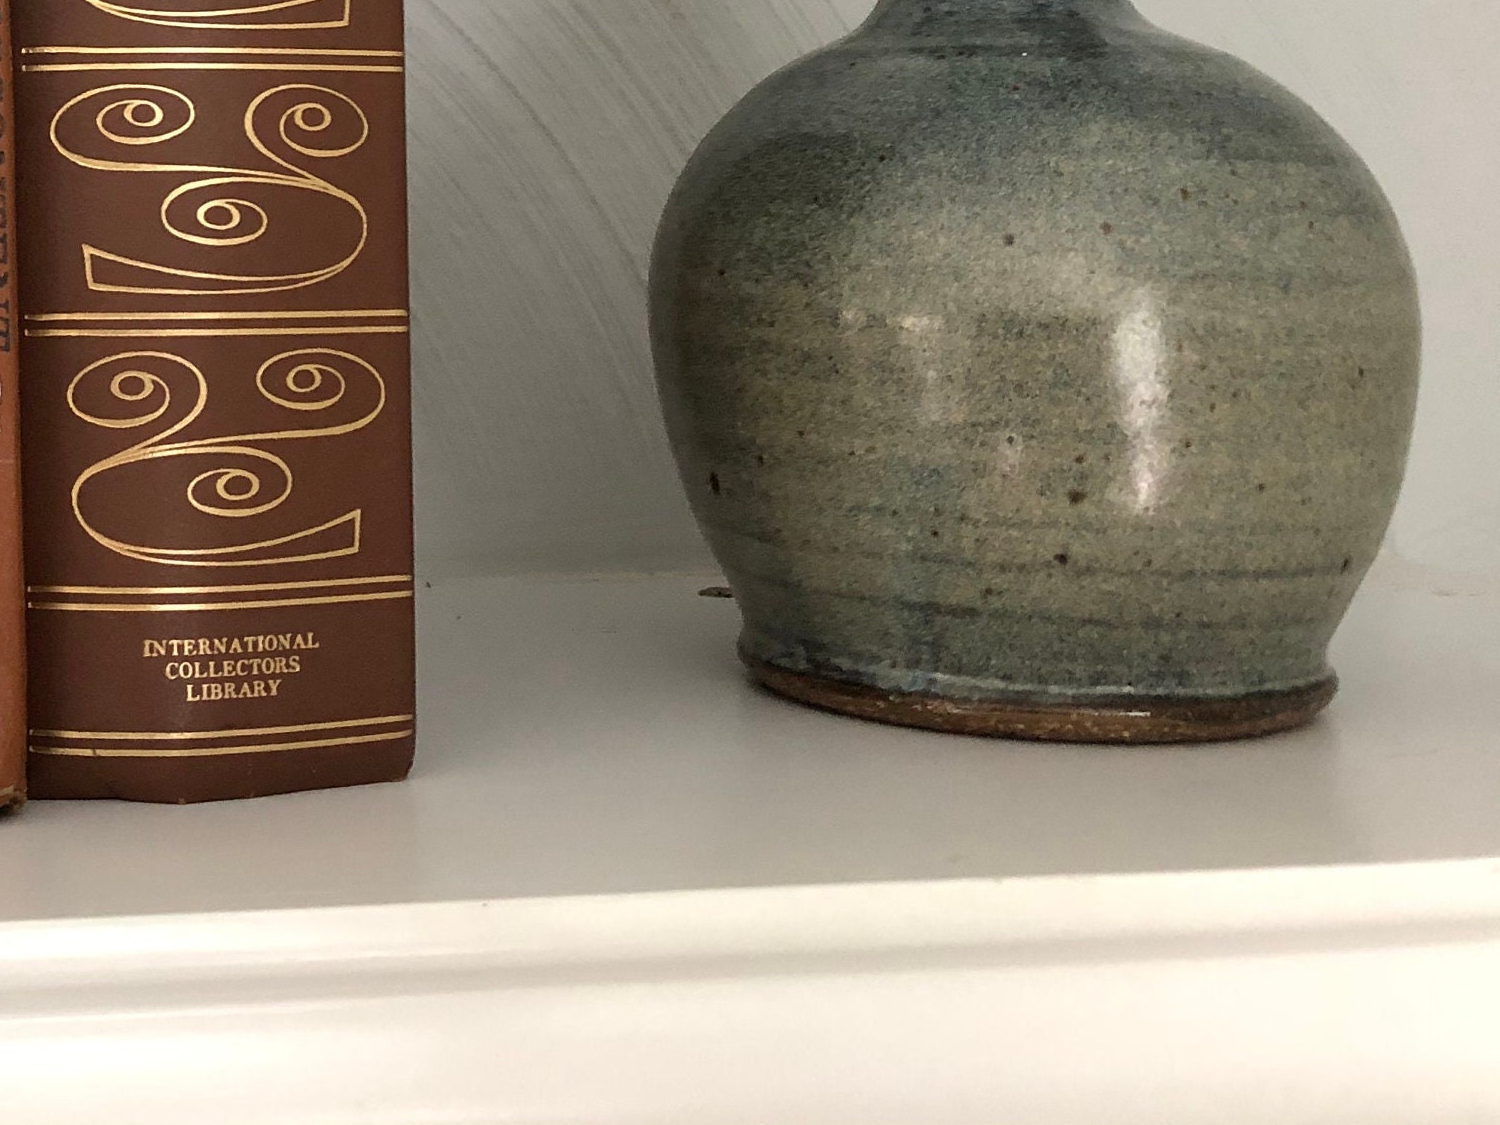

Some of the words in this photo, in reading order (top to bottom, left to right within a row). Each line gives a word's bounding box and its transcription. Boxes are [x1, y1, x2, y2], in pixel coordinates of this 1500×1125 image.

[142, 632, 320, 658] INTERNATIONAL
[165, 655, 301, 680] COLLECTORS
[186, 679, 282, 702] LIBRARY
